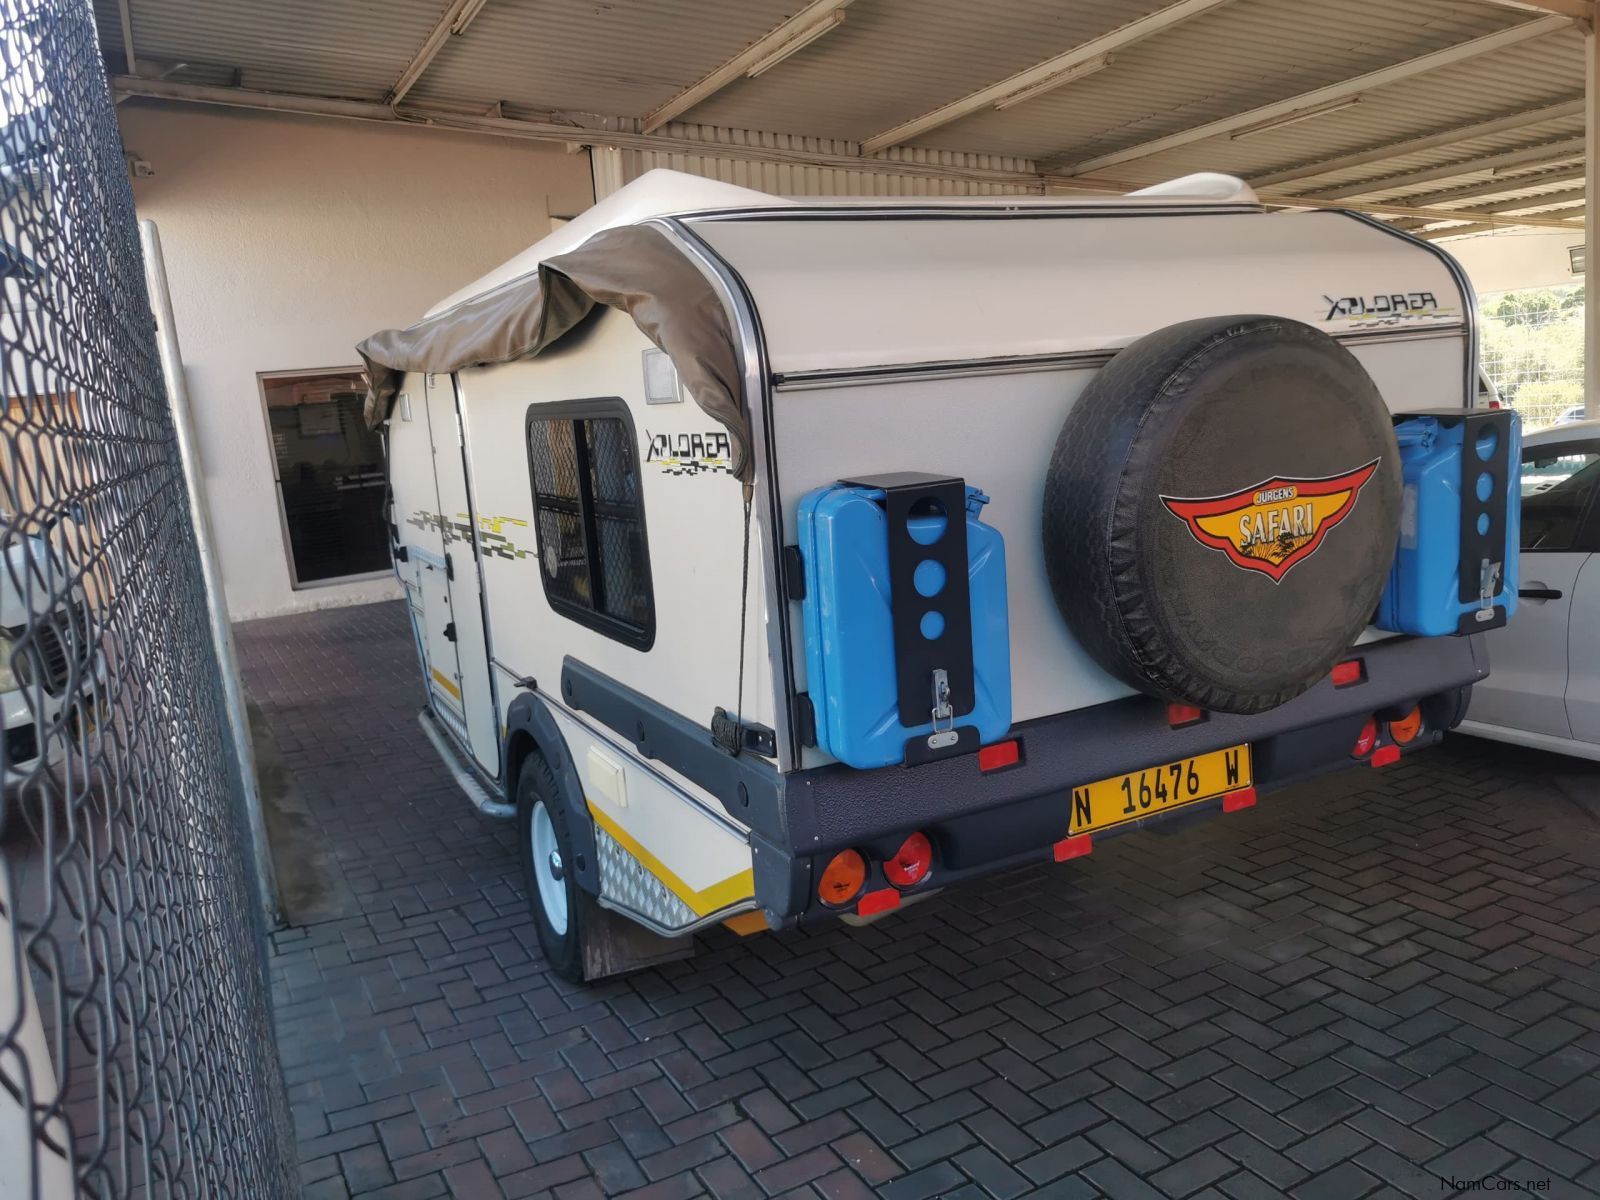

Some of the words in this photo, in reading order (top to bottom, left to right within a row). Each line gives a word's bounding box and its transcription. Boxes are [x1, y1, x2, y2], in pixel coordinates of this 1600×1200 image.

[1256, 487, 1294, 503] JURGENS
[1240, 503, 1313, 546] SAFARI
[1074, 788, 1092, 827] N
[1121, 760, 1199, 814] 16476
[1225, 750, 1239, 785] W
